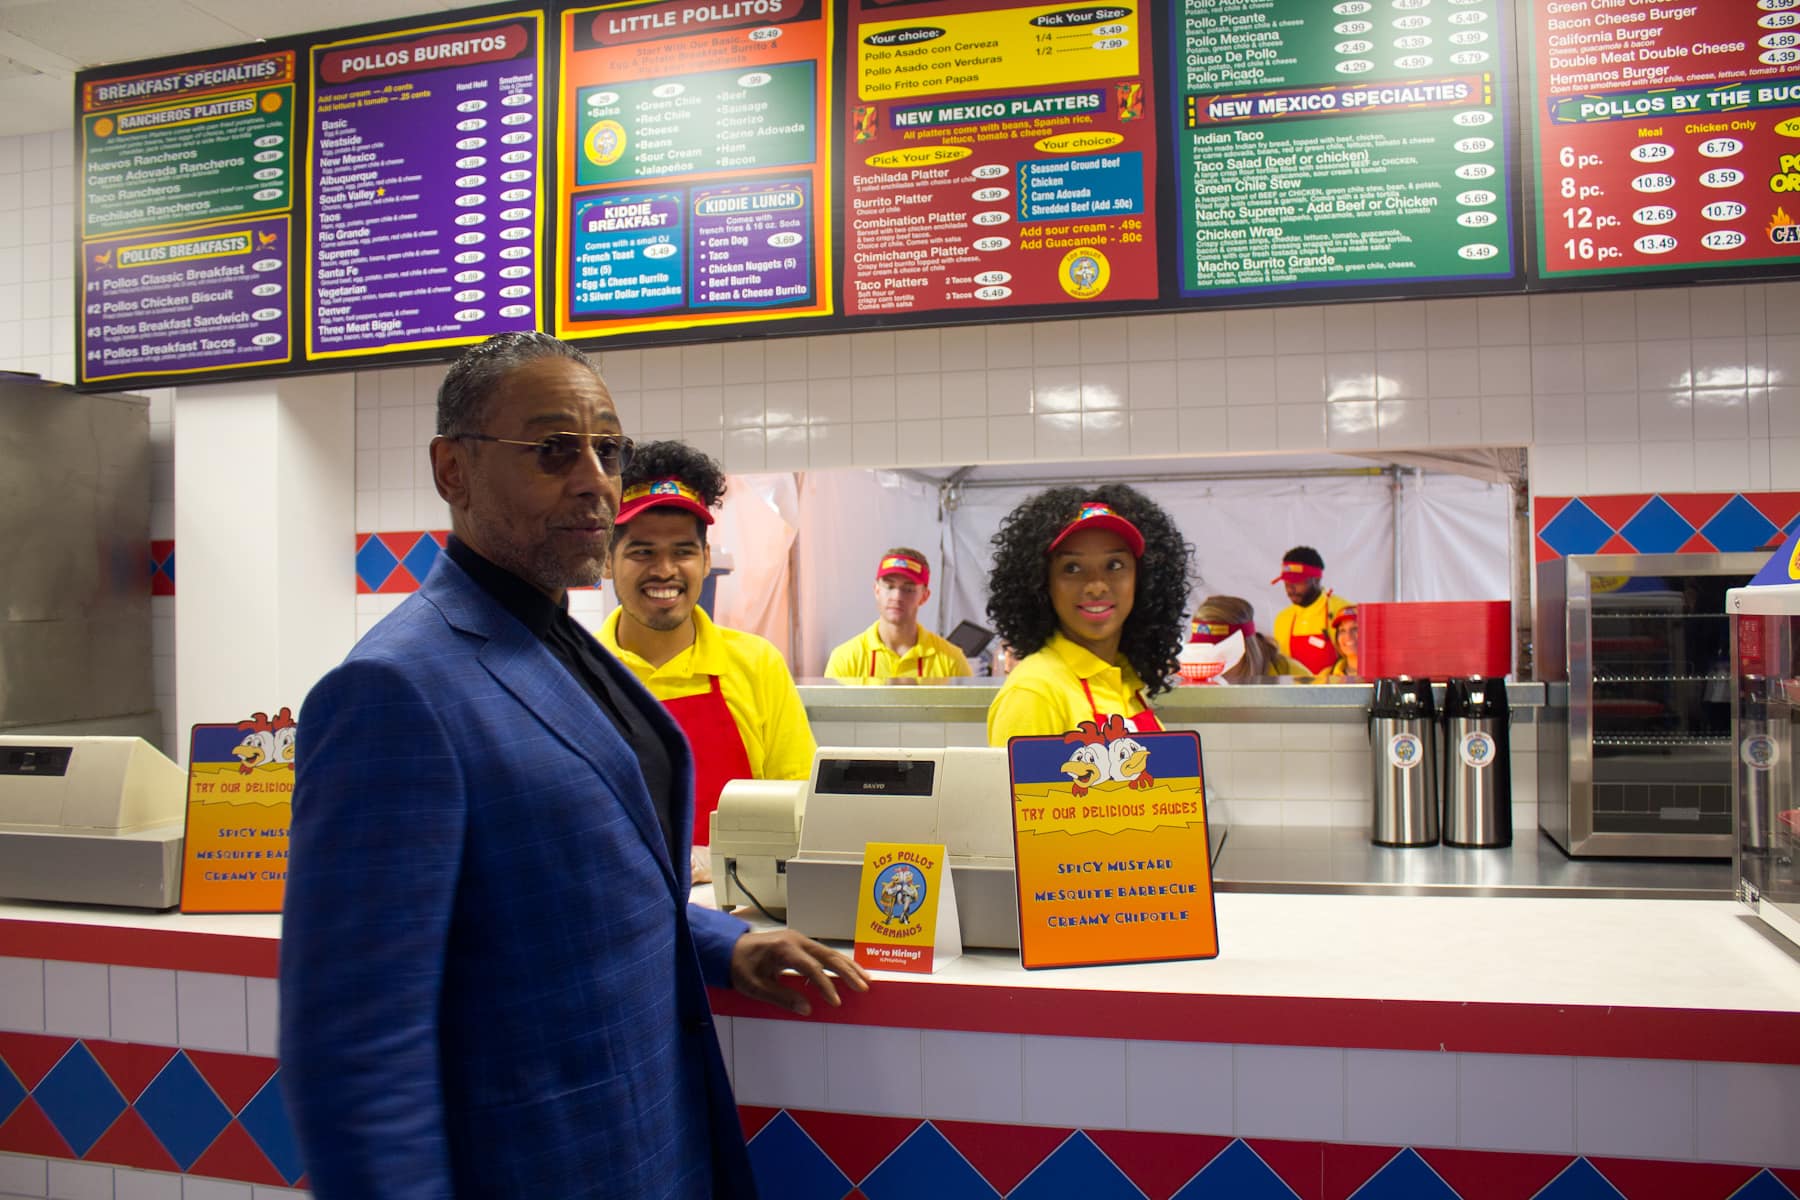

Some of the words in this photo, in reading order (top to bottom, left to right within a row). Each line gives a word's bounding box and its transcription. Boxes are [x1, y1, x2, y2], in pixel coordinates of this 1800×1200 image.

[609, 11, 675, 34] LITTLE
[683, 0, 782, 24] POLLITOS
[1038, 15, 1062, 25] Pick
[1066, 12, 1092, 24] Your
[1095, 9, 1124, 19] Size:
[1186, 17, 1216, 30] Pollo
[1220, 13, 1266, 26] Picante
[1548, 15, 1590, 30] Bacon
[1595, 11, 1646, 26] Cheese
[1651, 7, 1697, 24] Burger
[1767, 16, 1794, 26] 4.59
[753, 29, 778, 40] $2.49
[870, 34, 897, 44] Your
[899, 29, 939, 41] choice:
[1100, 25, 1122, 34] 5.49
[1549, 31, 1612, 47] California
[1616, 27, 1663, 43] Burger
[1100, 39, 1122, 48] 7.99
[1186, 35, 1216, 47] Pollo
[1220, 30, 1279, 44] Mexicana
[1768, 37, 1795, 46] 4.89
[342, 51, 408, 72] POLLOS
[414, 36, 506, 62] BURRITOS
[865, 50, 892, 61] Pollo
[895, 47, 928, 58] Asado
[931, 45, 951, 53] con
[954, 39, 998, 52] Cerveza
[1550, 54, 1597, 68] Double
[1601, 51, 1635, 63] Meat
[1639, 46, 1688, 60] Double
[1692, 41, 1745, 55] Cheese
[1768, 53, 1795, 62] 4.39
[865, 66, 892, 77] Pollo
[895, 63, 928, 73] Asado
[931, 61, 951, 70] con
[954, 55, 1002, 67] Verduras
[99, 75, 179, 101] BREAKFAST
[185, 62, 276, 88] SPECIALTIES
[865, 82, 892, 93] Pollo
[895, 79, 919, 89] Frito
[922, 78, 942, 86] con
[946, 73, 979, 86] Papas
[1551, 70, 1619, 85] Hermanos
[1623, 66, 1669, 82] Burger
[1209, 100, 1252, 118] NEW
[1259, 95, 1335, 113] MEXICO
[1342, 84, 1467, 107] SPECIALTIES
[1581, 98, 1664, 116] POLLOS
[1672, 94, 1701, 110] BY
[1708, 90, 1750, 105] THE
[1758, 86, 1800, 103] BUC
[120, 109, 191, 129] RANCHEROS
[195, 99, 254, 119] PLATTERS
[896, 110, 934, 126] NEW
[938, 104, 1005, 122] MEXICO
[1012, 95, 1099, 114] PLATTERS
[1639, 128, 1662, 137] Meal
[1686, 124, 1728, 134] Chicken
[1731, 121, 1756, 132] Only
[320, 136, 361, 148] Westside
[1194, 133, 1231, 145] Indian
[1234, 130, 1263, 142] Taco
[1640, 147, 1666, 157] 8.29
[1707, 142, 1734, 152] 6.79
[320, 157, 340, 167] New
[343, 152, 376, 164] Mexico
[1194, 161, 1223, 171] Taco
[1227, 157, 1262, 169] Salad
[1265, 155, 1297, 169] (beef
[1316, 150, 1369, 164] chicken)
[1560, 147, 1575, 167] 6
[1579, 155, 1603, 168] pc.
[320, 172, 378, 186] Albuquerque
[853, 171, 908, 186] Enchilada
[911, 169, 949, 181] Platter
[980, 167, 1000, 177] 5.99
[1709, 173, 1736, 183] 8.59
[1195, 183, 1232, 195] Green
[1235, 180, 1267, 192] Chile
[1270, 178, 1301, 190] Stew
[1561, 177, 1576, 198] 8
[1580, 185, 1604, 200] pc.
[1637, 177, 1672, 187] 10.89
[319, 194, 346, 204] South
[348, 190, 375, 202] Valley
[706, 197, 748, 213] KIDDIE
[752, 193, 794, 208] LUNCH
[853, 196, 892, 209] Burrito
[895, 193, 932, 205] Platter
[605, 204, 651, 219] KIDDIE
[1196, 209, 1236, 221] Nacho
[1239, 205, 1294, 220] Supreme
[1307, 202, 1335, 214] Add
[1338, 200, 1365, 211] Beef
[1368, 200, 1381, 209] or
[1385, 195, 1437, 209] Chicken
[1639, 210, 1674, 220] 12.69
[1708, 206, 1742, 216] 10.79
[589, 214, 667, 232] BREAKFAST
[853, 215, 925, 229] Combination
[928, 212, 966, 224] Platter
[1464, 214, 1489, 225] 4.99
[1563, 207, 1592, 228] 12
[1596, 216, 1621, 229] pc.
[1197, 228, 1246, 241] Chicken
[1249, 226, 1282, 240] Wrap
[1707, 235, 1742, 245] 12.29
[122, 247, 166, 264] POLLOS
[170, 238, 245, 257] BREAKFASTS
[1564, 238, 1593, 259] 16
[1598, 247, 1622, 261] pc.
[1640, 238, 1675, 248] 13.49
[854, 249, 928, 263] Chimichanga
[932, 247, 969, 258] Platter
[1466, 247, 1490, 257] 5.49
[709, 263, 743, 274] Chicken
[746, 260, 782, 272] Nuggets
[784, 258, 796, 269] (5)
[1198, 260, 1239, 273] Macho
[1243, 257, 1284, 270] Burrito
[1288, 254, 1335, 268] Grande
[88, 279, 100, 292] #1
[104, 275, 138, 290] Pollos
[141, 271, 183, 286] Classic
[186, 265, 245, 281] Breakfast
[318, 285, 367, 299] Vegetarian
[196, 783, 215, 792] TRY
[221, 783, 240, 792] OUR
[246, 783, 292, 792] DELICIOU
[1022, 808, 1044, 821] TRY
[1053, 807, 1075, 819] OUR
[1083, 804, 1145, 818] DELICIOUS
[1152, 802, 1198, 815] SAUCES
[218, 829, 256, 837] SPICY
[872, 853, 892, 870] LOS
[898, 851, 934, 870] POLLOS
[1057, 861, 1103, 874] SPICY
[1108, 859, 1173, 871] MUSTARD
[205, 872, 257, 880] CREAMY
[1034, 888, 1113, 902] MESQUITE
[1118, 883, 1197, 897] BARBECUE
[1048, 913, 1110, 927] CREAMY
[1115, 910, 1189, 924] CHIPOTLE
[870, 922, 922, 939] HERMANOS
[866, 947, 889, 956] We're
[891, 948, 921, 959] Hiring!
